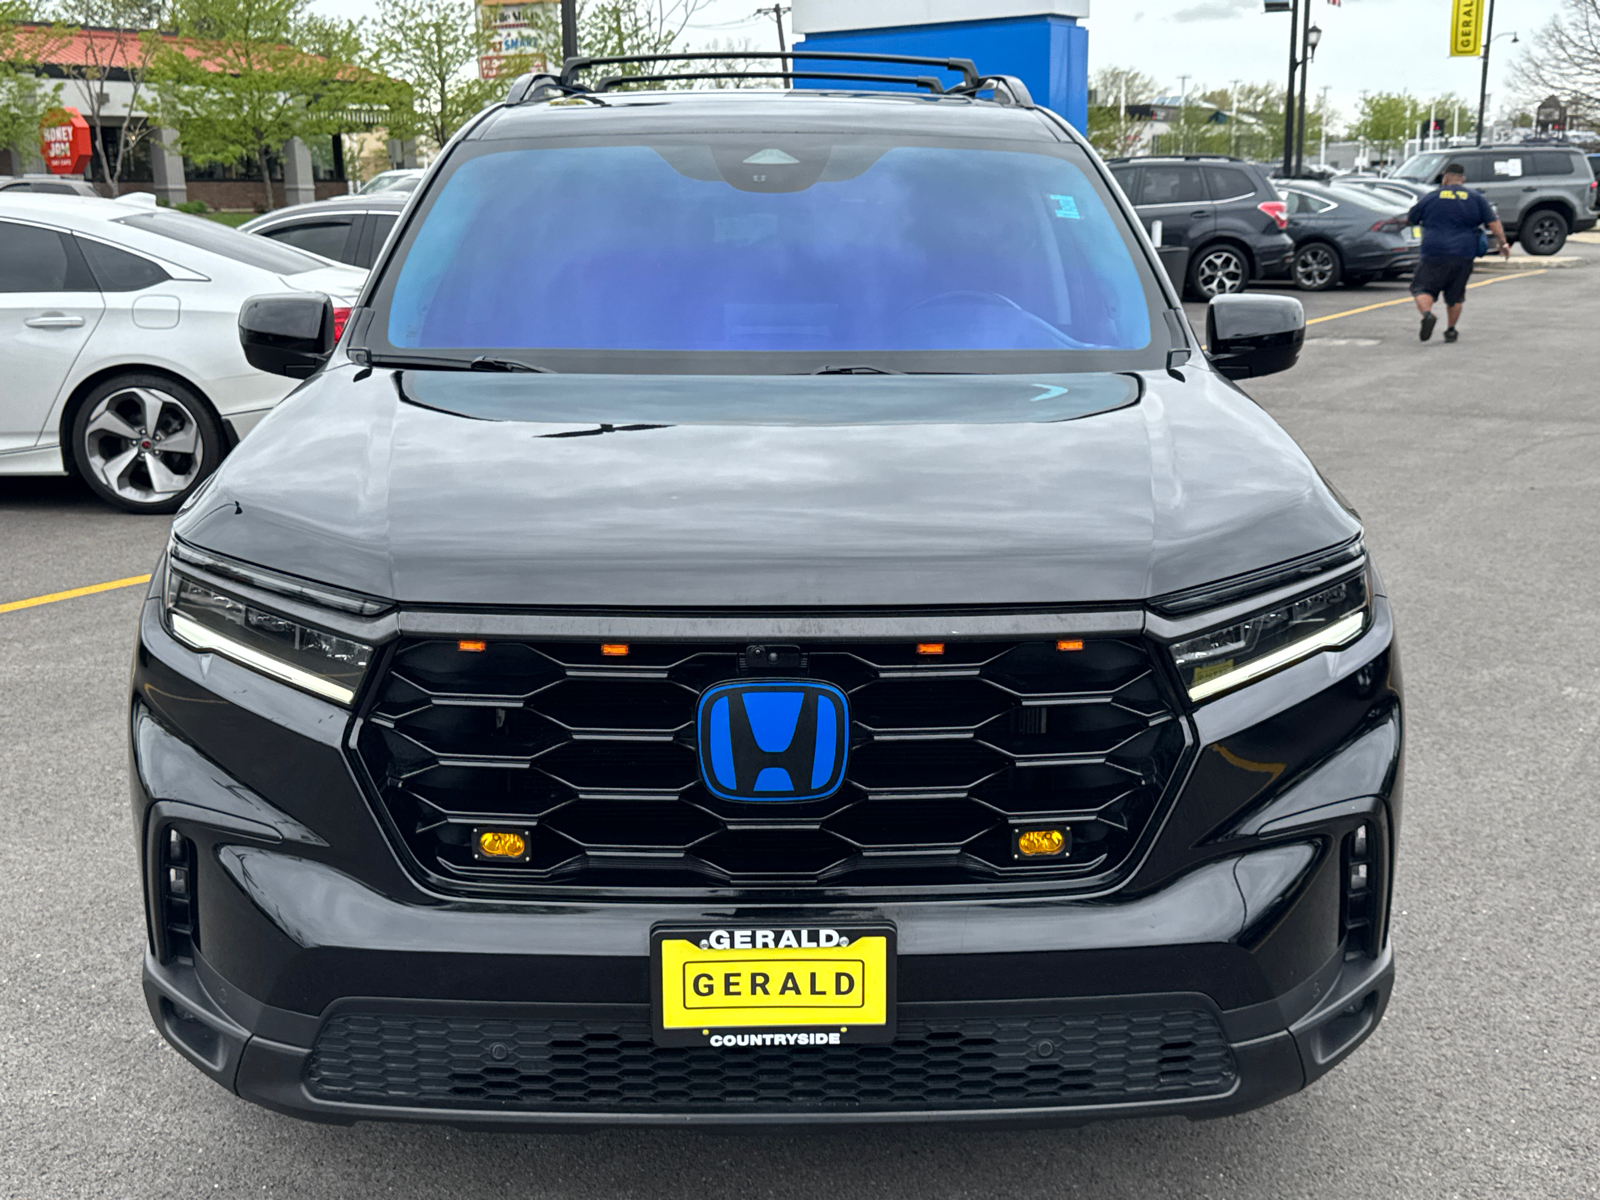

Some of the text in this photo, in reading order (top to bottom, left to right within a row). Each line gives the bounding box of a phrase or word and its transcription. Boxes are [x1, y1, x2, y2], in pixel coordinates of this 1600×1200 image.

[487, 36, 538, 52] ETSMART
[43, 126, 73, 142] HONEY
[709, 929, 839, 949] GERALD
[693, 971, 855, 997] GERALD
[709, 1032, 841, 1047] COUNTRYSIDE
